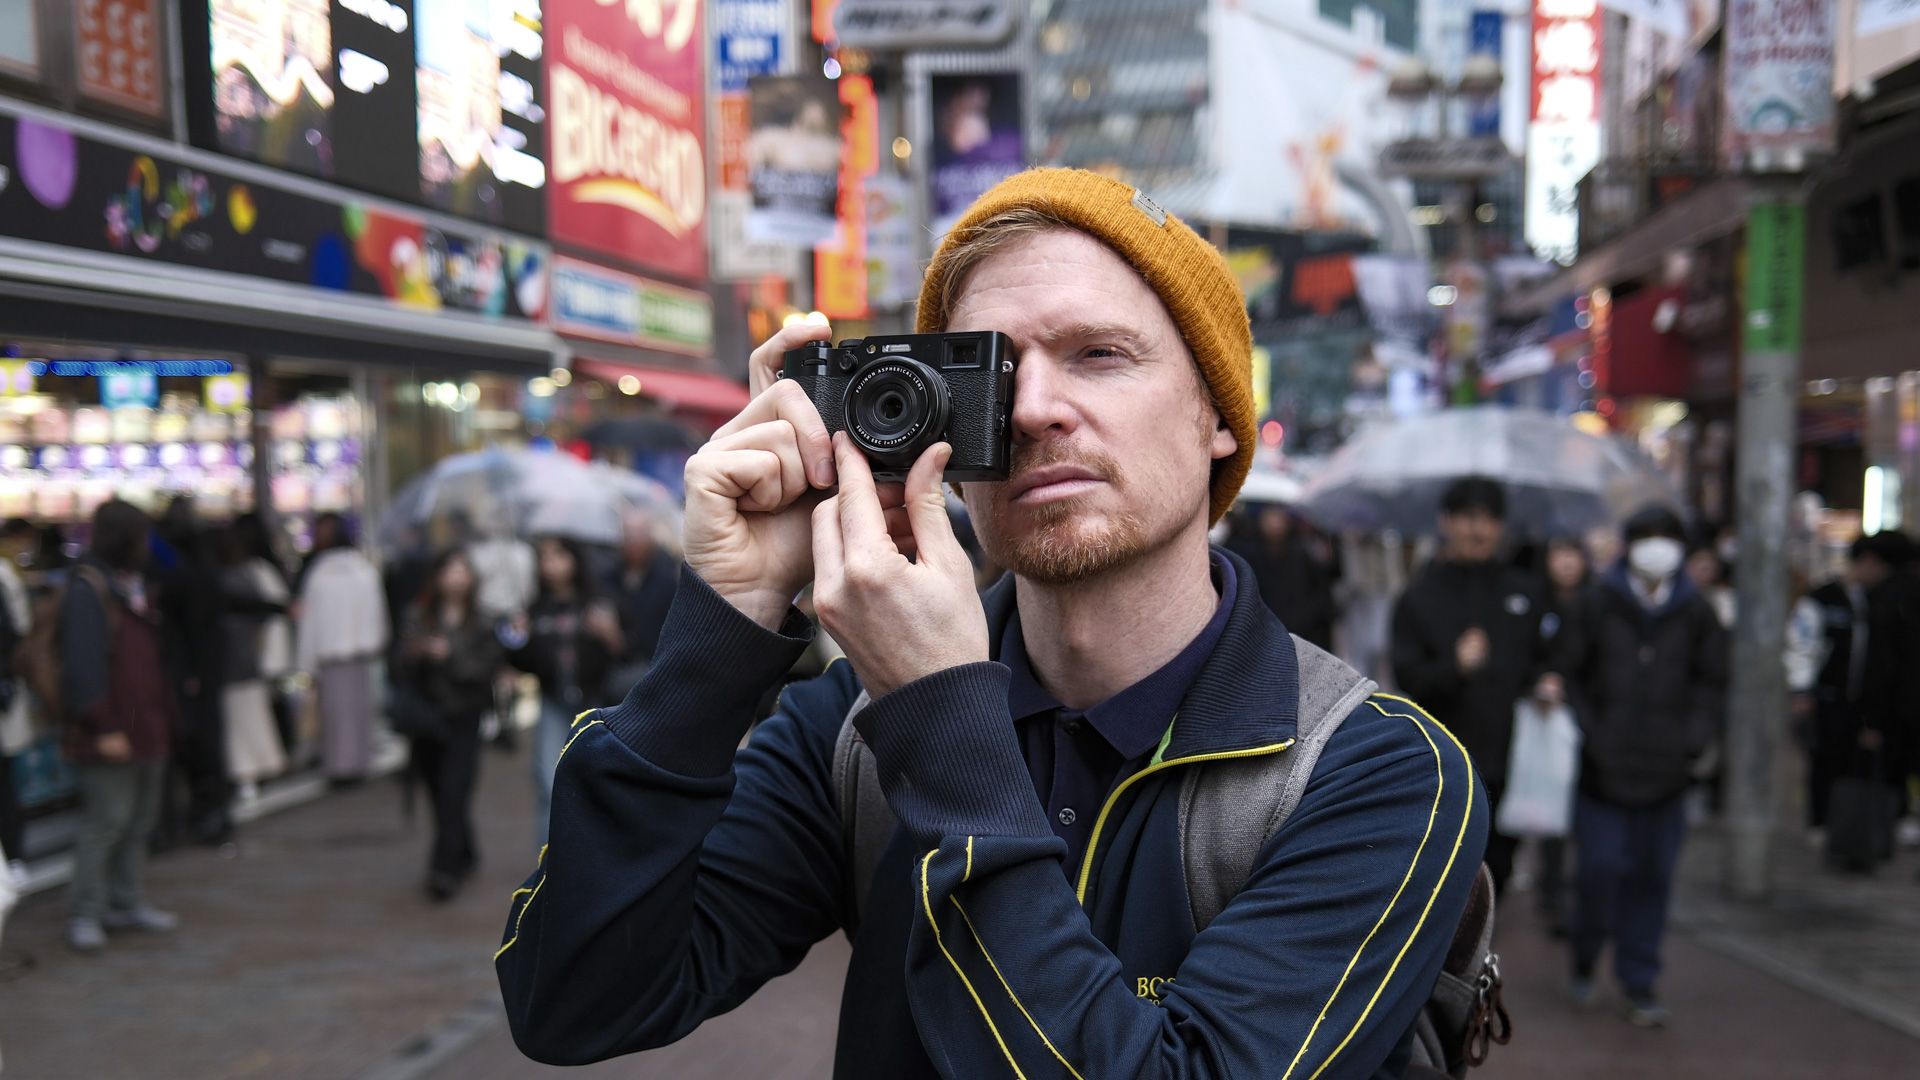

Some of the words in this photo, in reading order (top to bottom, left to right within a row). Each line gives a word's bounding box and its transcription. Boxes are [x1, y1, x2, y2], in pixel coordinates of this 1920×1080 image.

[855, 371, 876, 394] FUJINON
[877, 366, 912, 378] ASPHERICAL
[913, 377, 924, 391] LENS
[856, 425, 870, 440] SUPER
